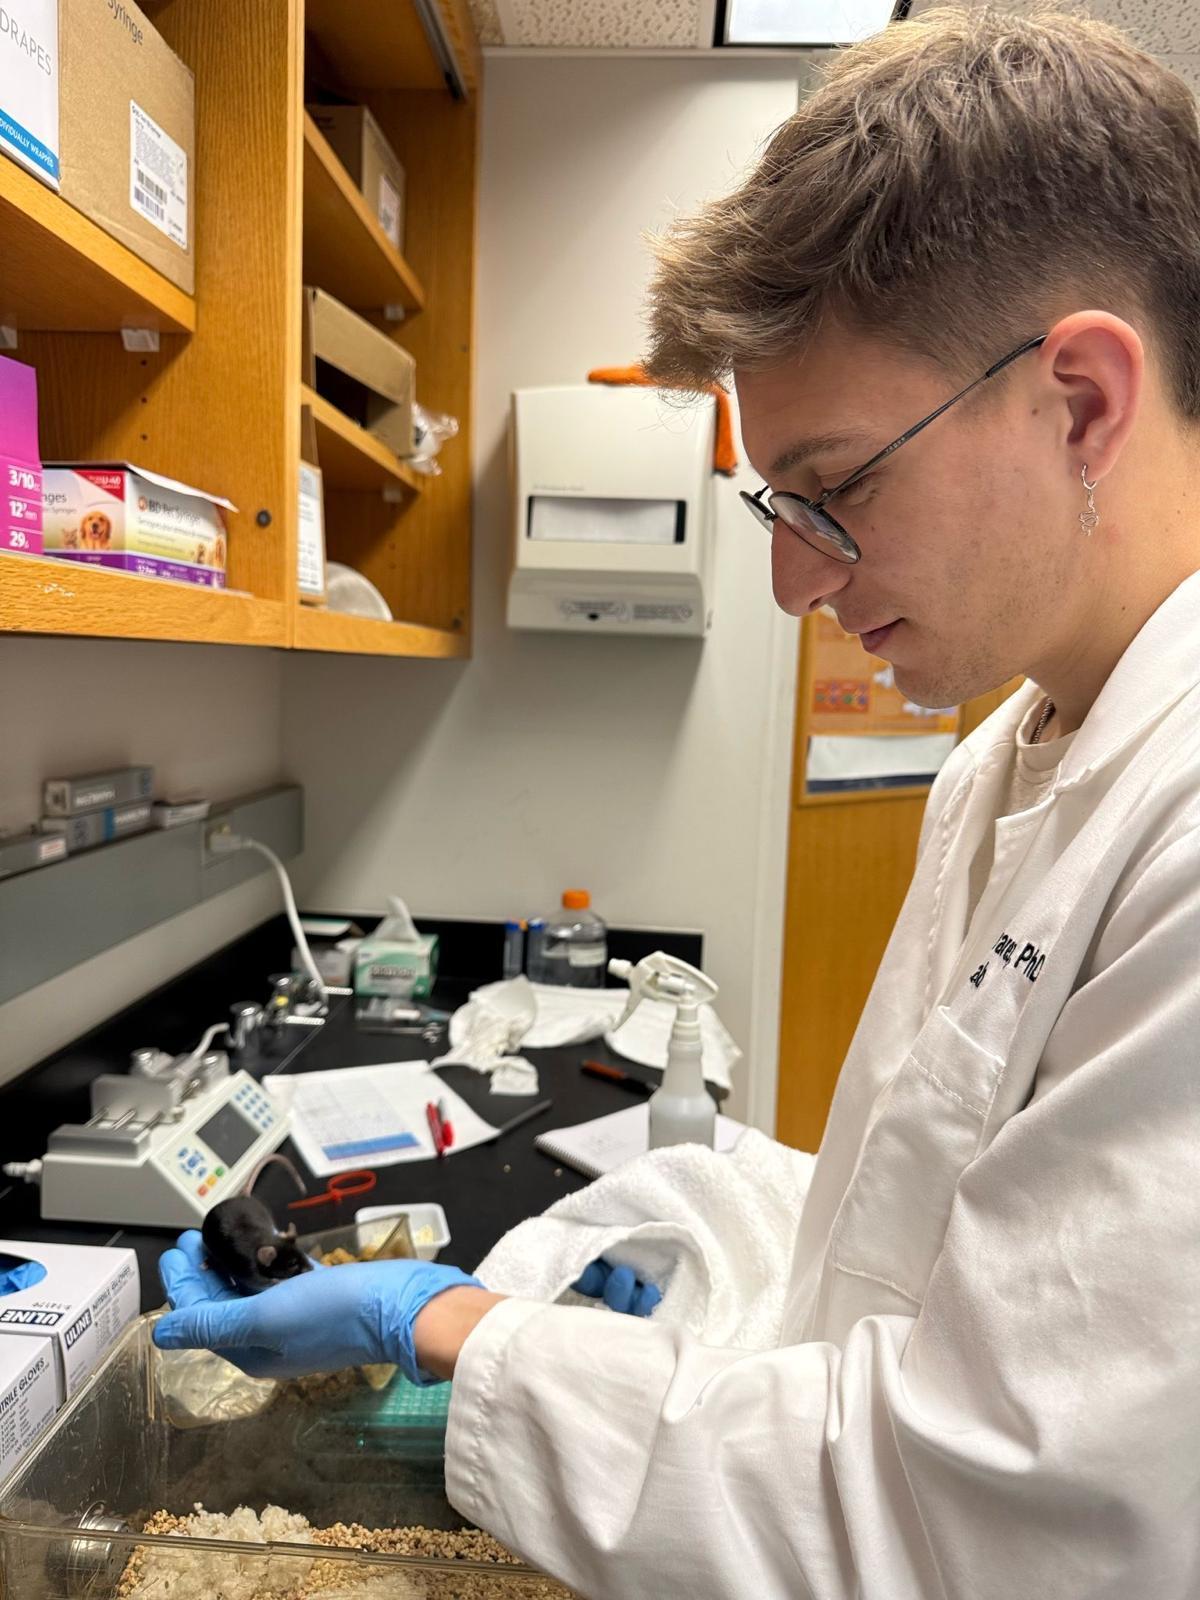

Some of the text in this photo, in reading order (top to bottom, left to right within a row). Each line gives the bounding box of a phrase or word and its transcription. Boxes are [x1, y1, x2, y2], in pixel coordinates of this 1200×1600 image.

[0, 8, 52, 76] DRAPES
[1013, 942, 1046, 982] PhD
[0, 1310, 60, 1325] ULINE
[66, 1311, 92, 1347] ULINE
[19, 1359, 45, 1391] GLOVES
